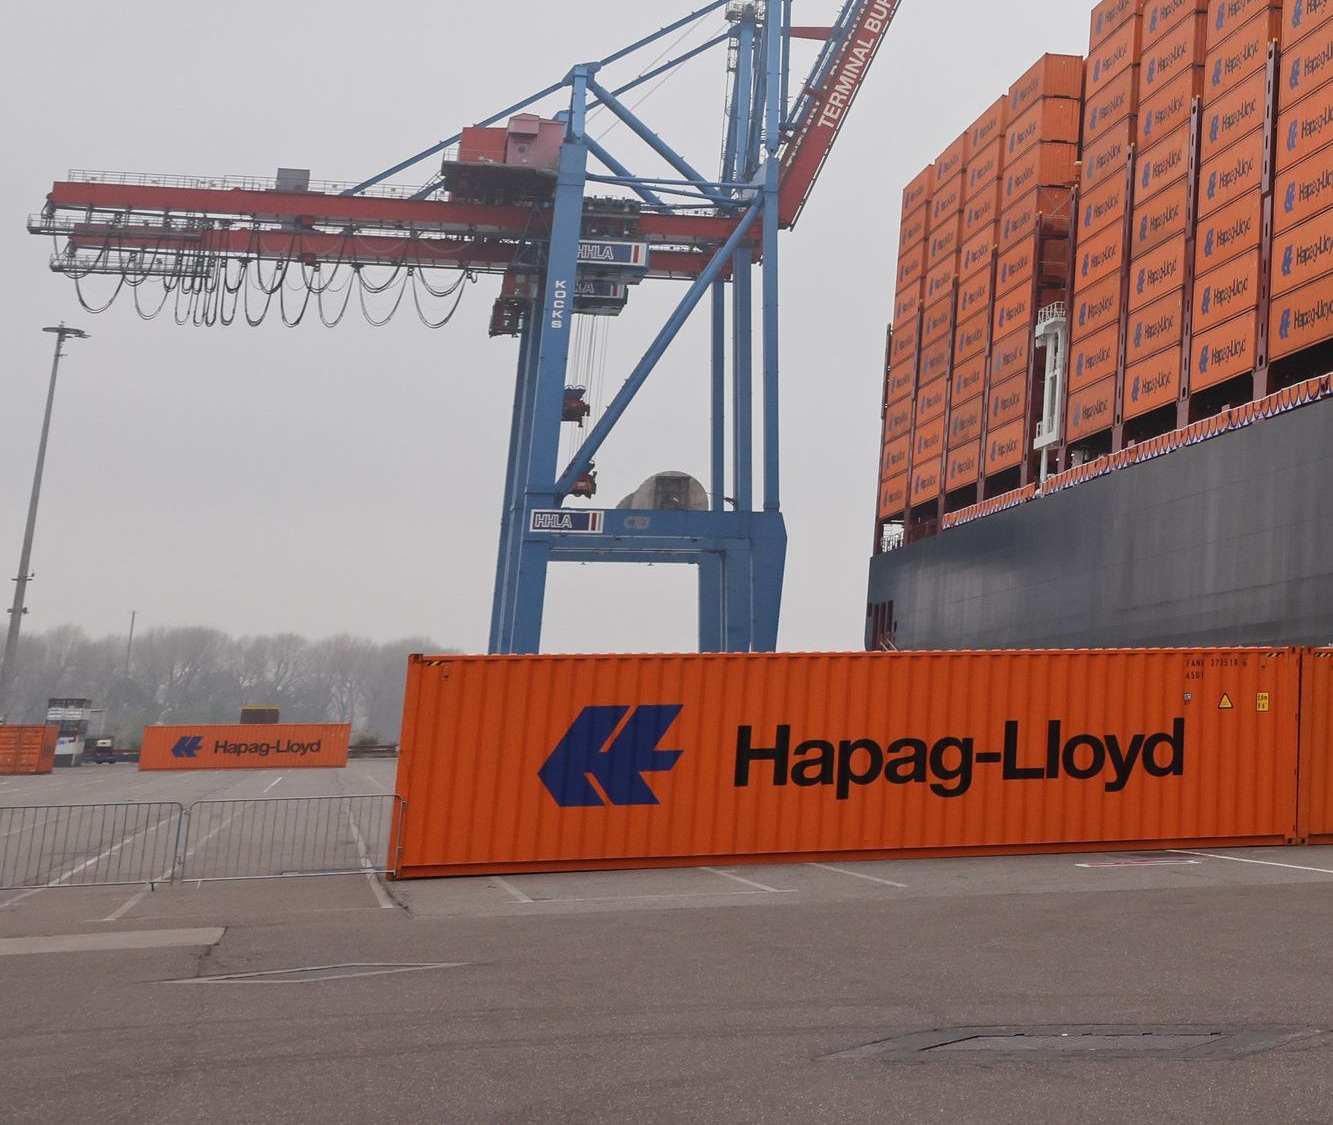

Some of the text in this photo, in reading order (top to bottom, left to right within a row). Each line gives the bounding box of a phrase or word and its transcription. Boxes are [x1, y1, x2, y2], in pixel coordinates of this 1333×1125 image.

[817, 37, 875, 129] TERMINAL
[552, 280, 567, 329] KOCKS
[535, 514, 572, 528] HHLA
[214, 739, 321, 756] Hapag-Lloyd
[734, 717, 1185, 800] Hapag-Lloyd
